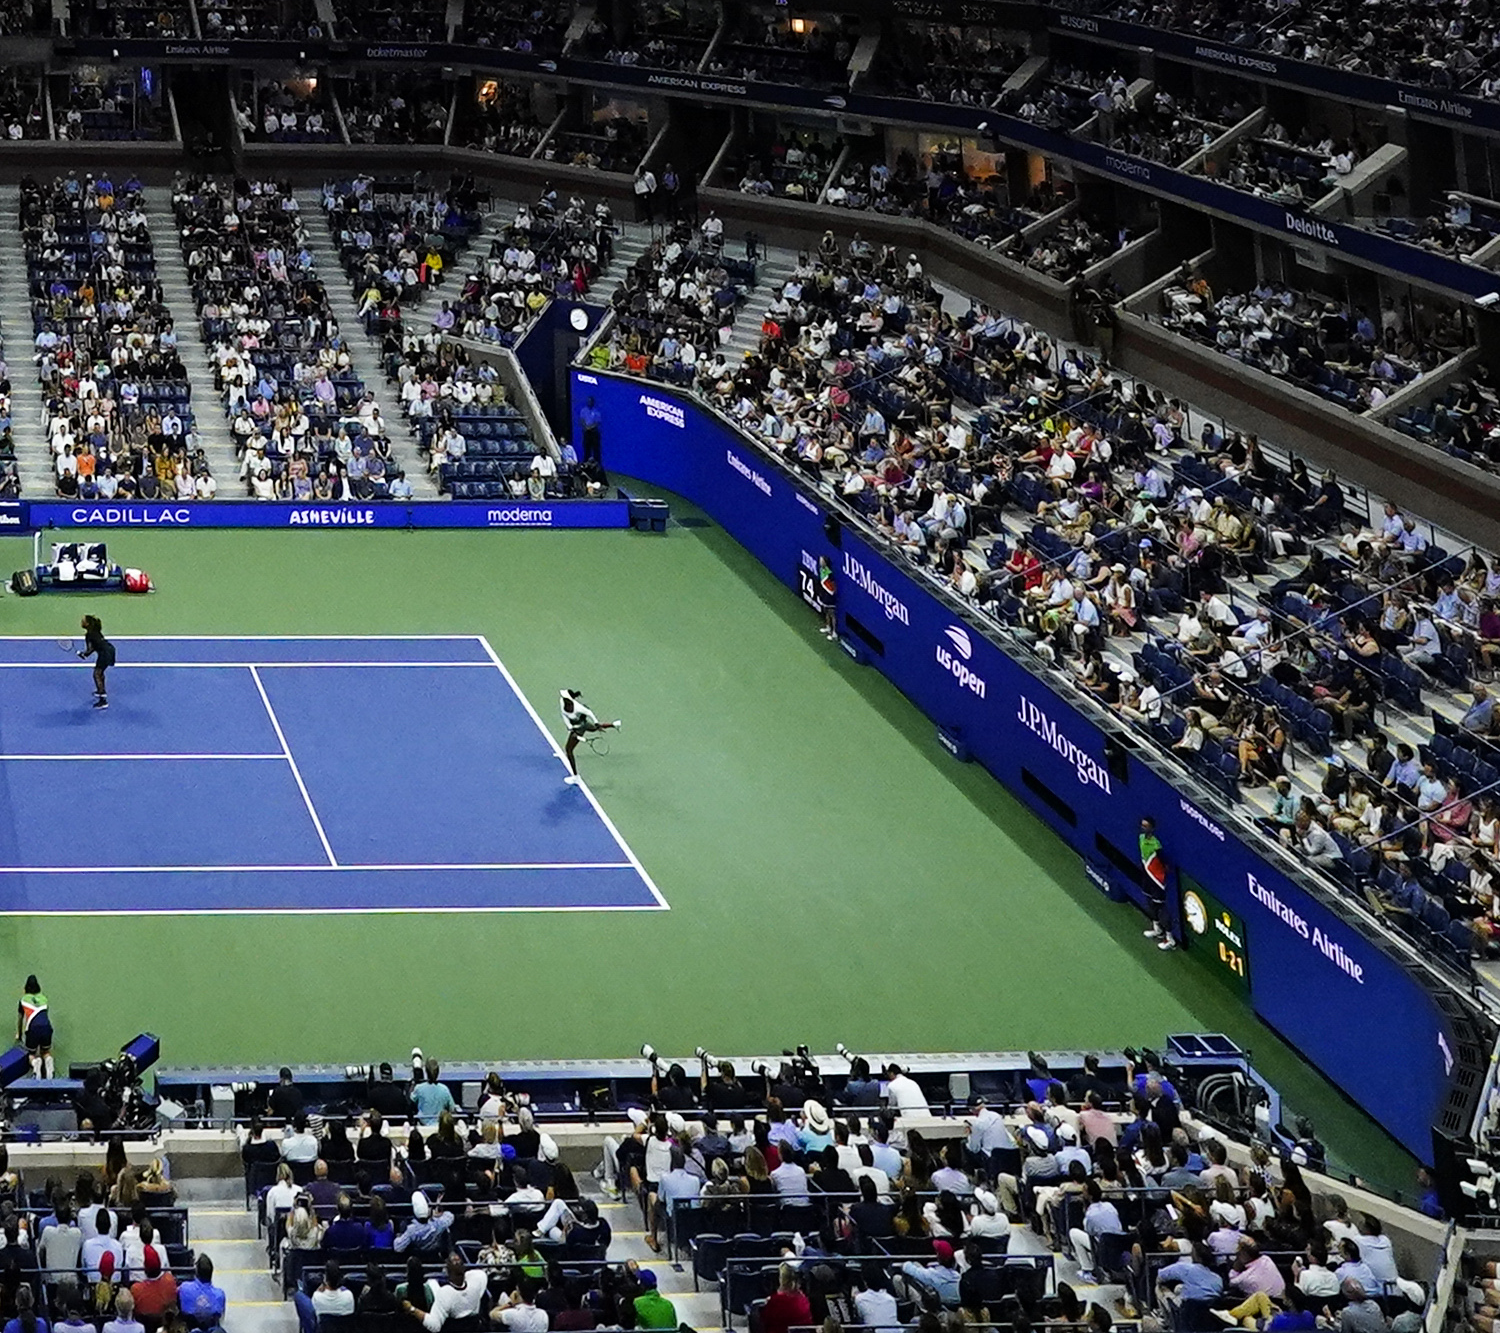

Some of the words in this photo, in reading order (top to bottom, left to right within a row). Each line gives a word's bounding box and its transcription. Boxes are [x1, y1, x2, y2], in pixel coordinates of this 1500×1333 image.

[366, 47, 428, 58] ticketmaster
[1194, 45, 1237, 66] AMERICAN
[1237, 54, 1278, 74] EXPRESS
[647, 74, 698, 89] AMERICAN
[700, 81, 747, 95] EXPRESS
[1397, 90, 1439, 111] Emirates
[1440, 99, 1473, 119] Airline
[1105, 155, 1151, 180] moderna
[1285, 211, 1340, 245] Deloitte.
[639, 394, 684, 419] AMERICAN
[646, 405, 685, 429] EXPRESS
[726, 449, 752, 482] Emirates
[71, 508, 191, 524] CADILLAC
[488, 508, 553, 522] moderna
[841, 550, 910, 626] J.P.Morgan
[935, 644, 953, 671] us
[952, 660, 987, 700] open
[1017, 695, 1112, 797] J.P.Morgan
[1179, 797, 1226, 842] USOPEN.ORG
[1214, 917, 1242, 949] ROLEX
[1247, 872, 1311, 942] Emirates
[1311, 924, 1365, 984] Airline
